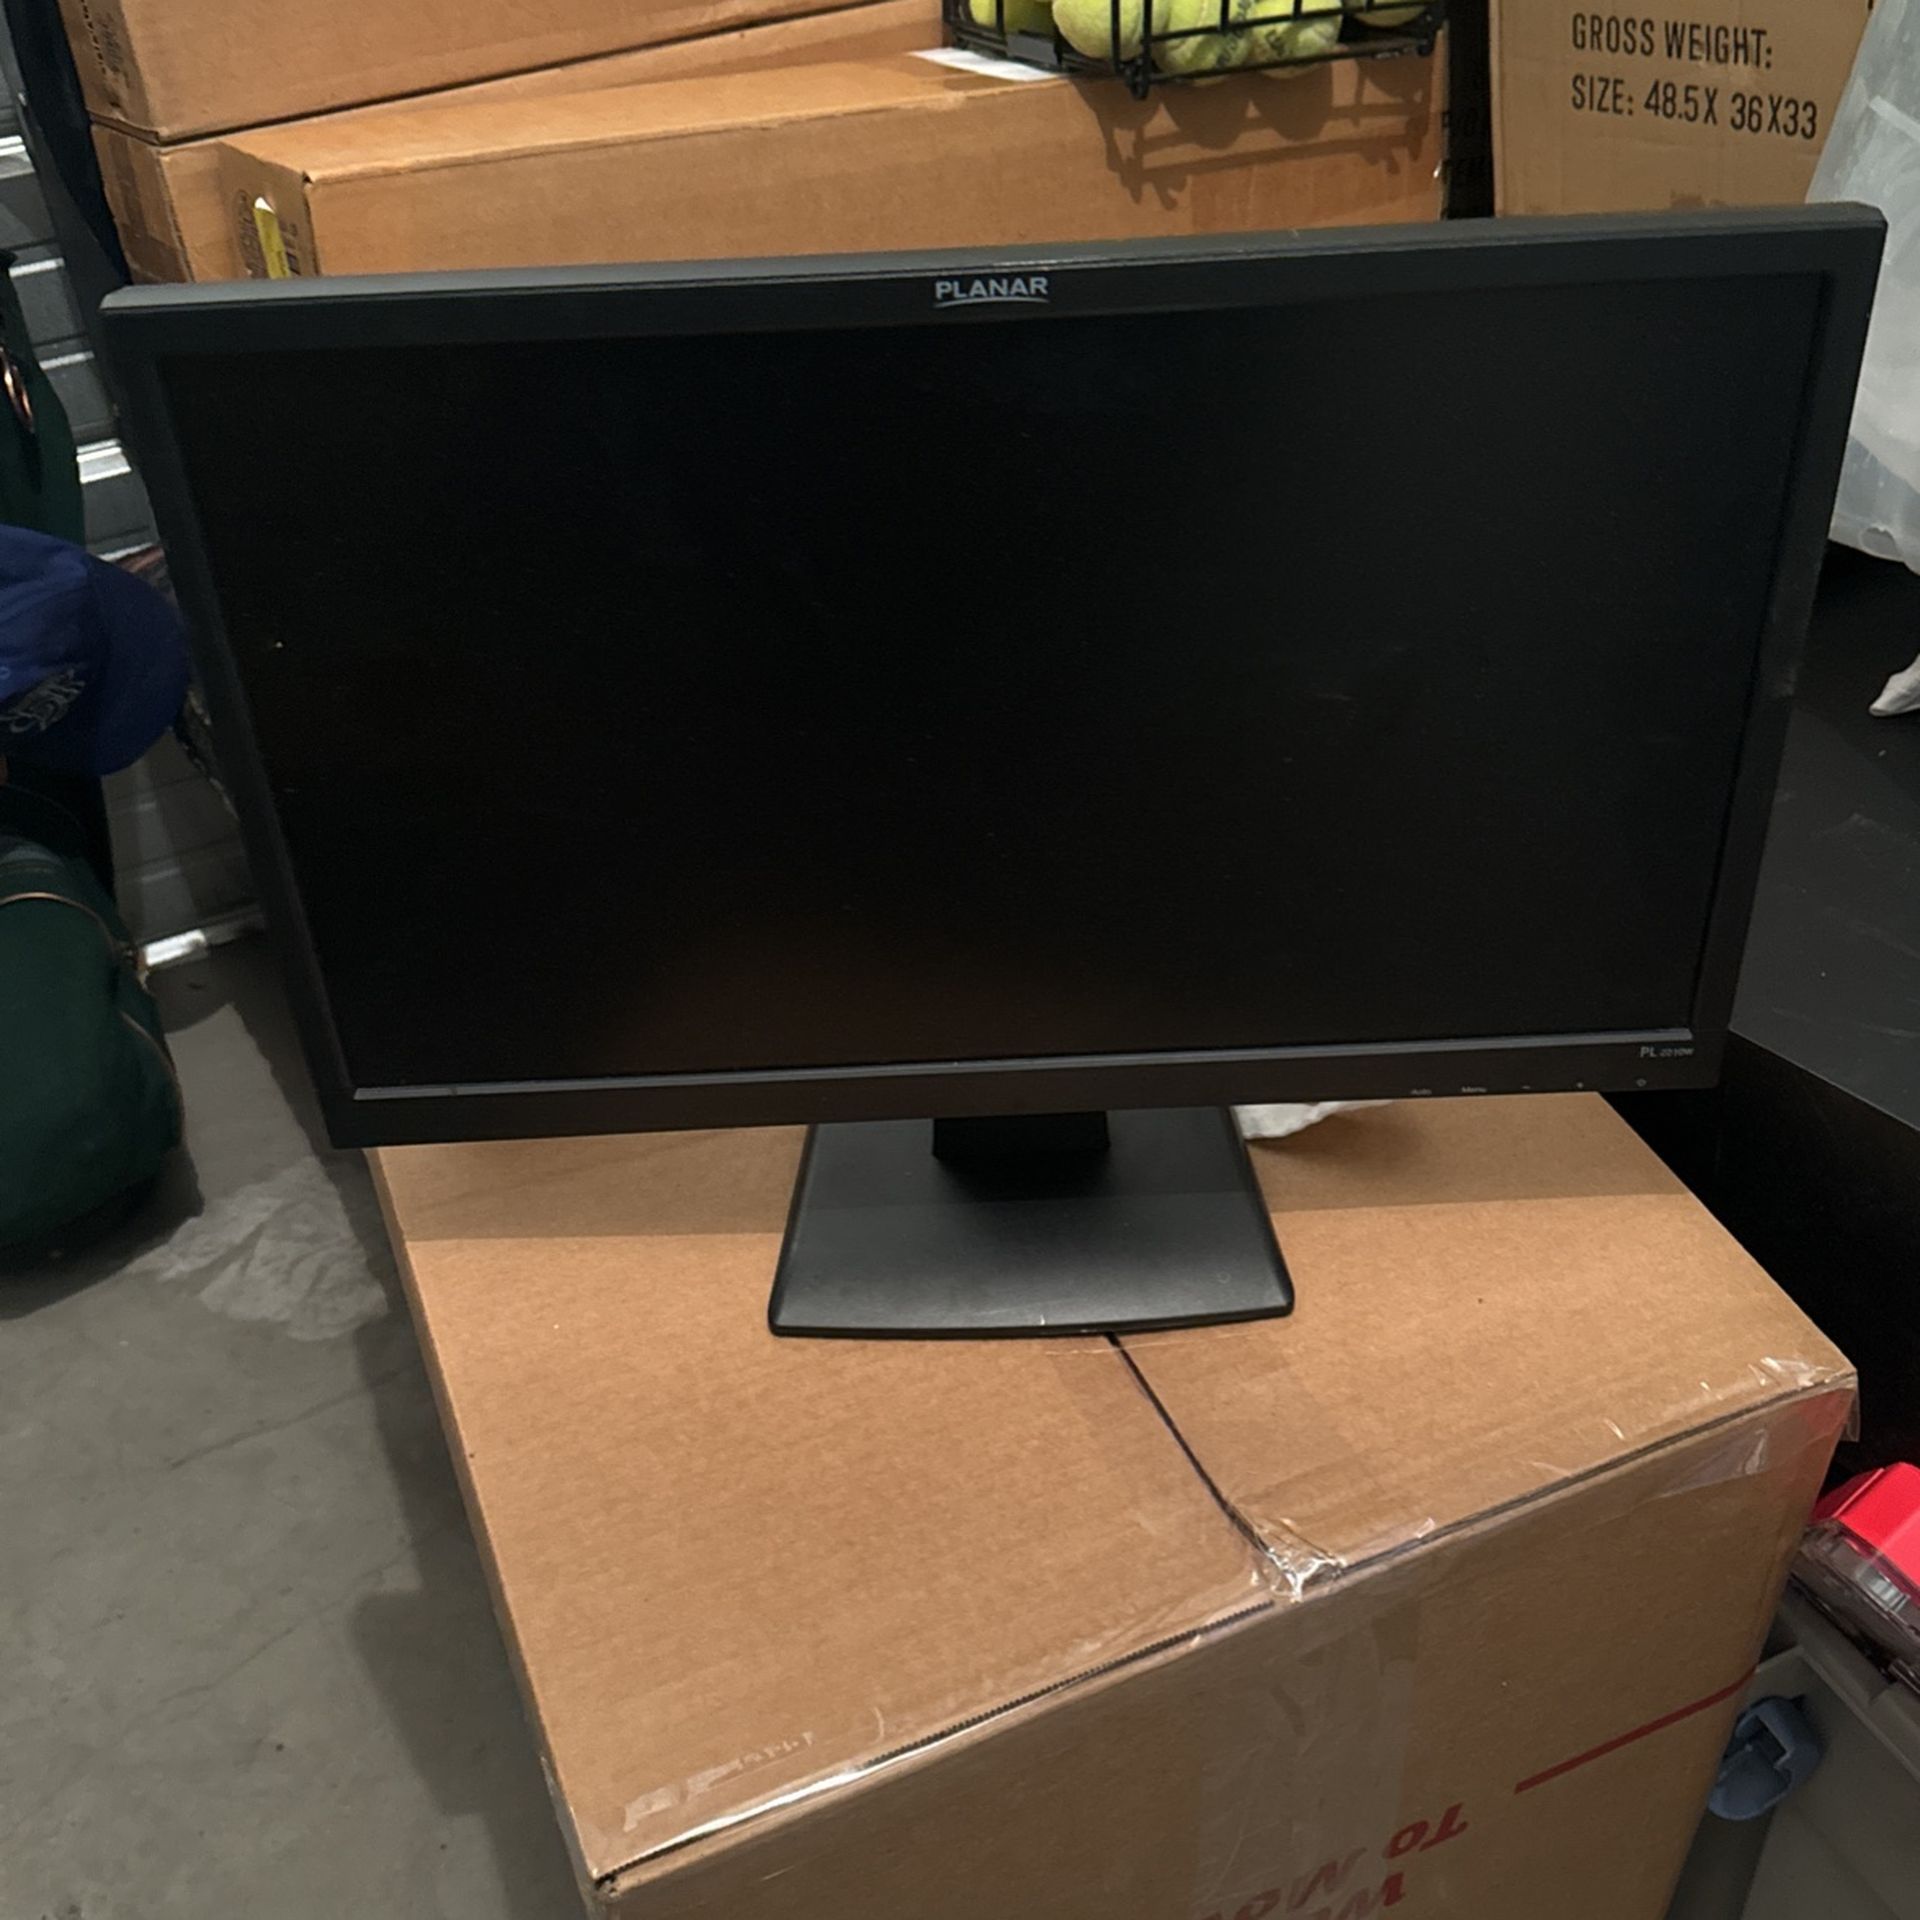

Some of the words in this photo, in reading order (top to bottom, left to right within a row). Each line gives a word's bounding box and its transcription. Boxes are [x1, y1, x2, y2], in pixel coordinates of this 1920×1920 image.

[1572, 12, 1655, 56] GROSS
[1664, 20, 1773, 69] WEIGHT:
[1571, 74, 1634, 116] SIZE:
[1644, 80, 1719, 126] 48.5X
[1730, 92, 1818, 140] 36X33
[934, 276, 1049, 300] PLANAR
[1639, 1045, 1657, 1058] PL
[1383, 1802, 1469, 1859] TO
